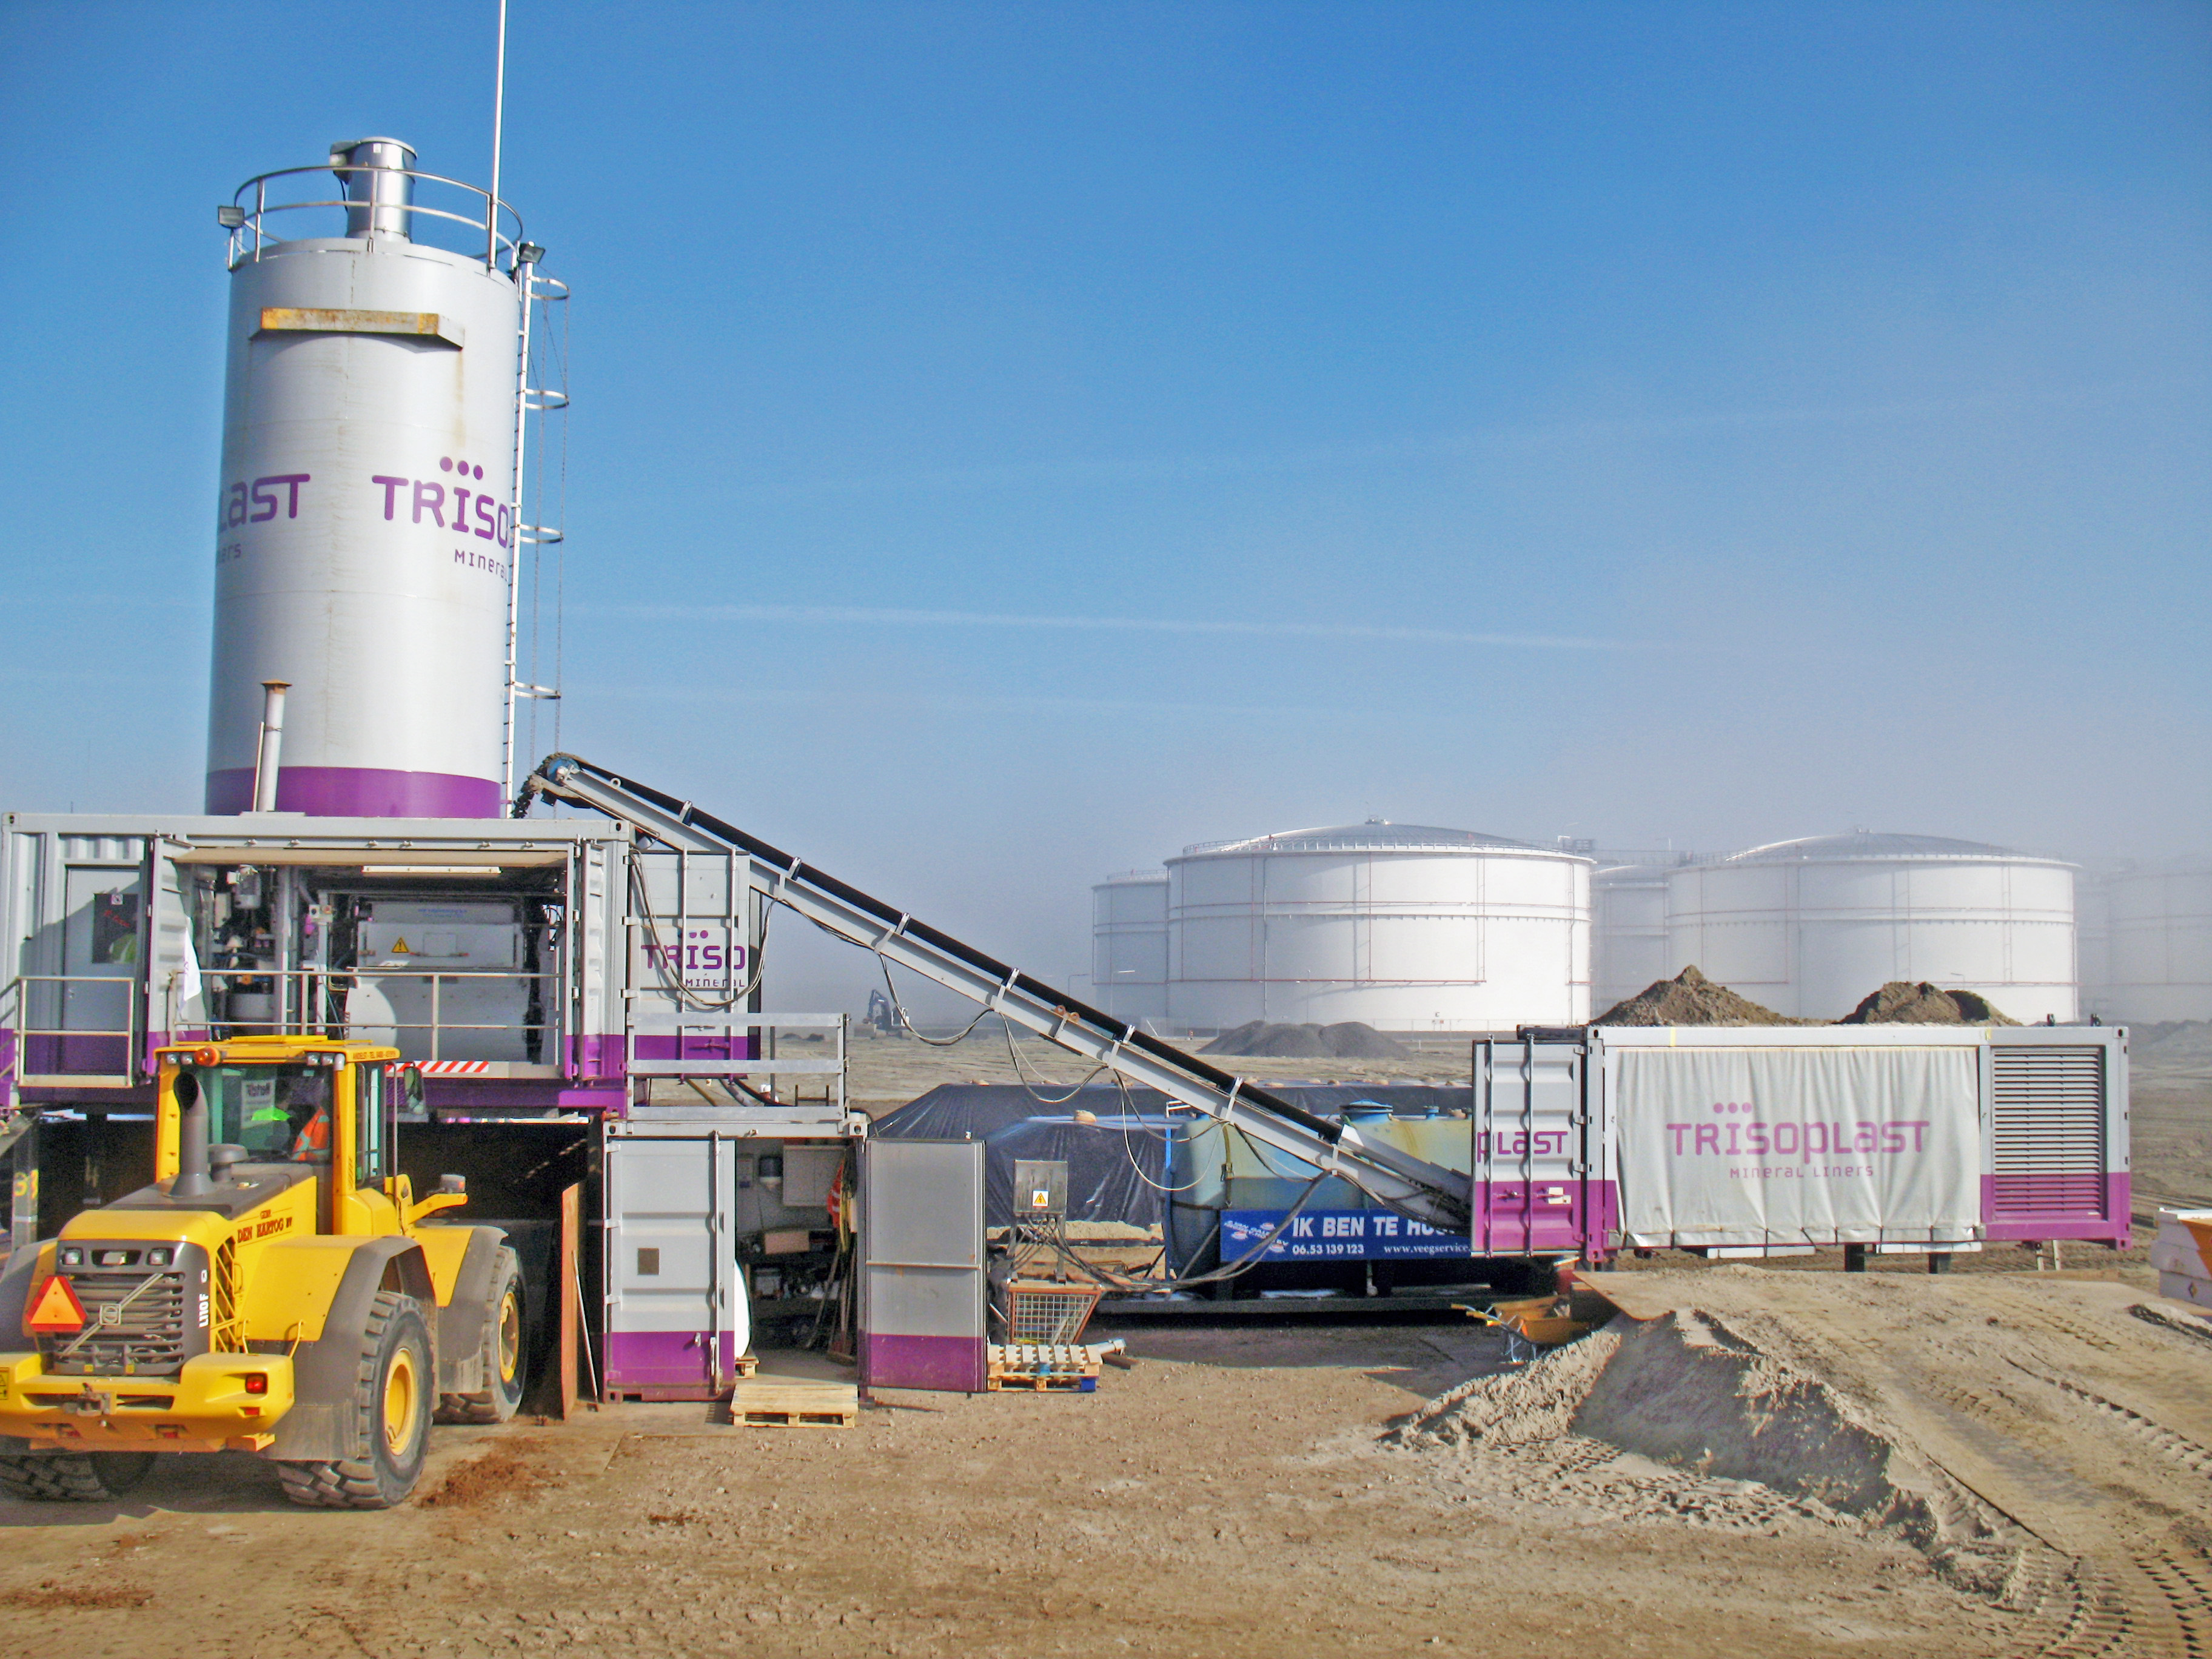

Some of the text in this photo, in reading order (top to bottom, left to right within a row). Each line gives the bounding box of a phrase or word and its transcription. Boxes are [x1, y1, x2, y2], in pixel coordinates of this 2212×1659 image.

[1292, 1216, 1315, 1237] IK
[1322, 1216, 1365, 1237] BEN
[1373, 1216, 1399, 1236] TE
[1292, 1244, 1365, 1255] 06.53 139 123
